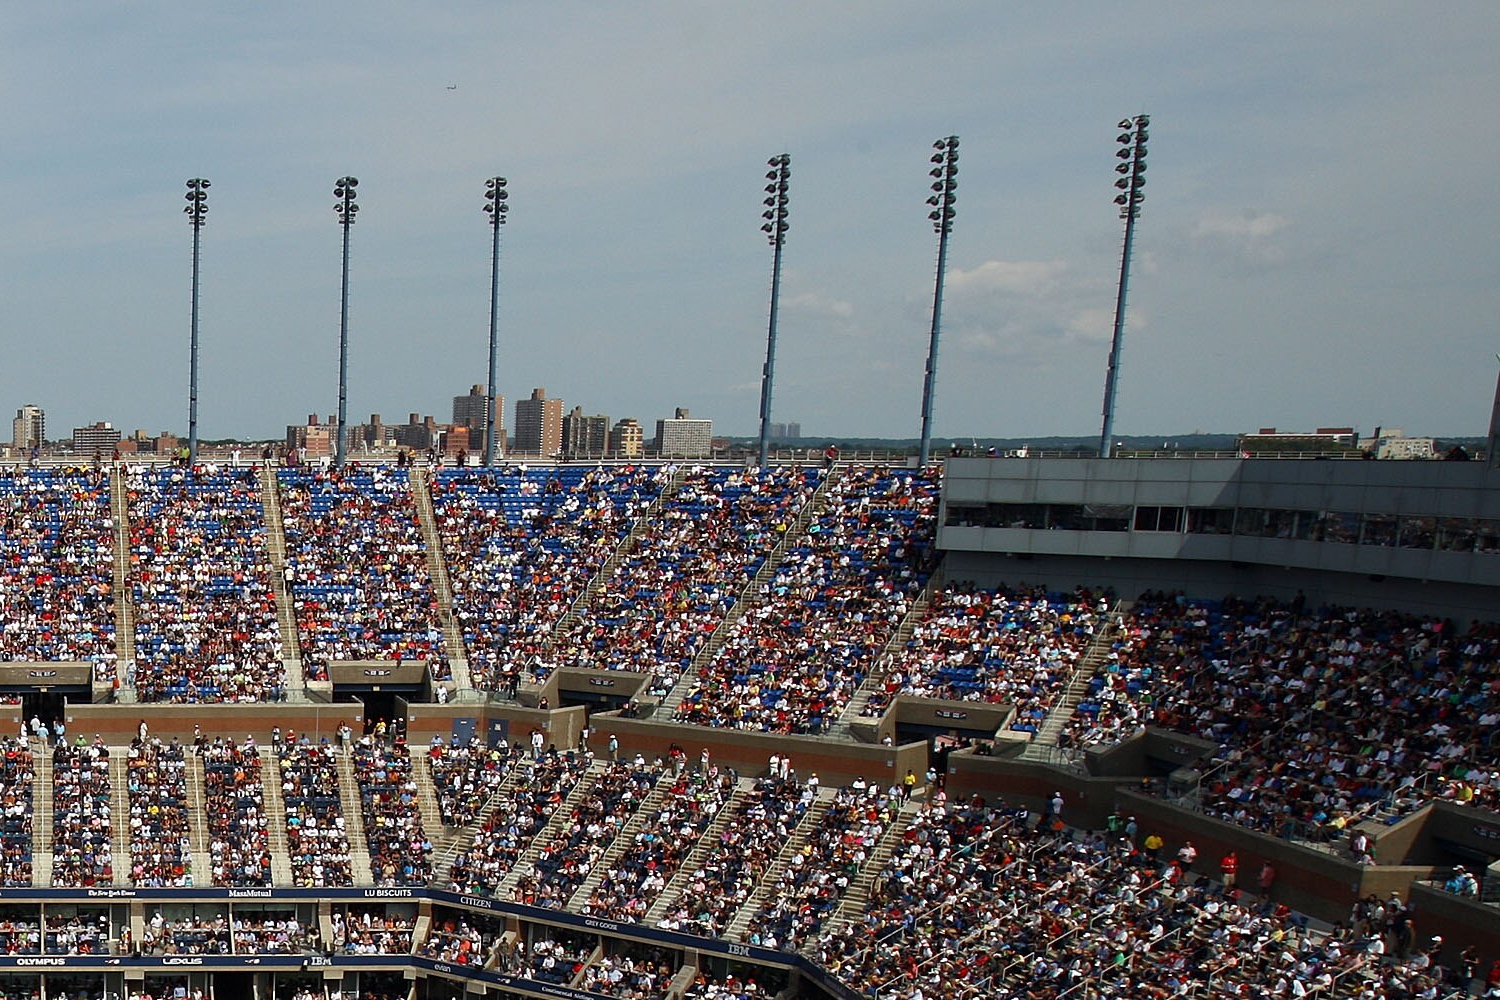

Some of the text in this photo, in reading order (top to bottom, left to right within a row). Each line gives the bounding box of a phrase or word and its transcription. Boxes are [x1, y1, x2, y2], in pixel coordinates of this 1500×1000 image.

[364, 889, 412, 897] LU BISCUITS
[460, 896, 492, 908] CITIZEN
[727, 943, 749, 956] IBM
[16, 958, 66, 966] OLYMPUS
[311, 956, 332, 966] IBM
